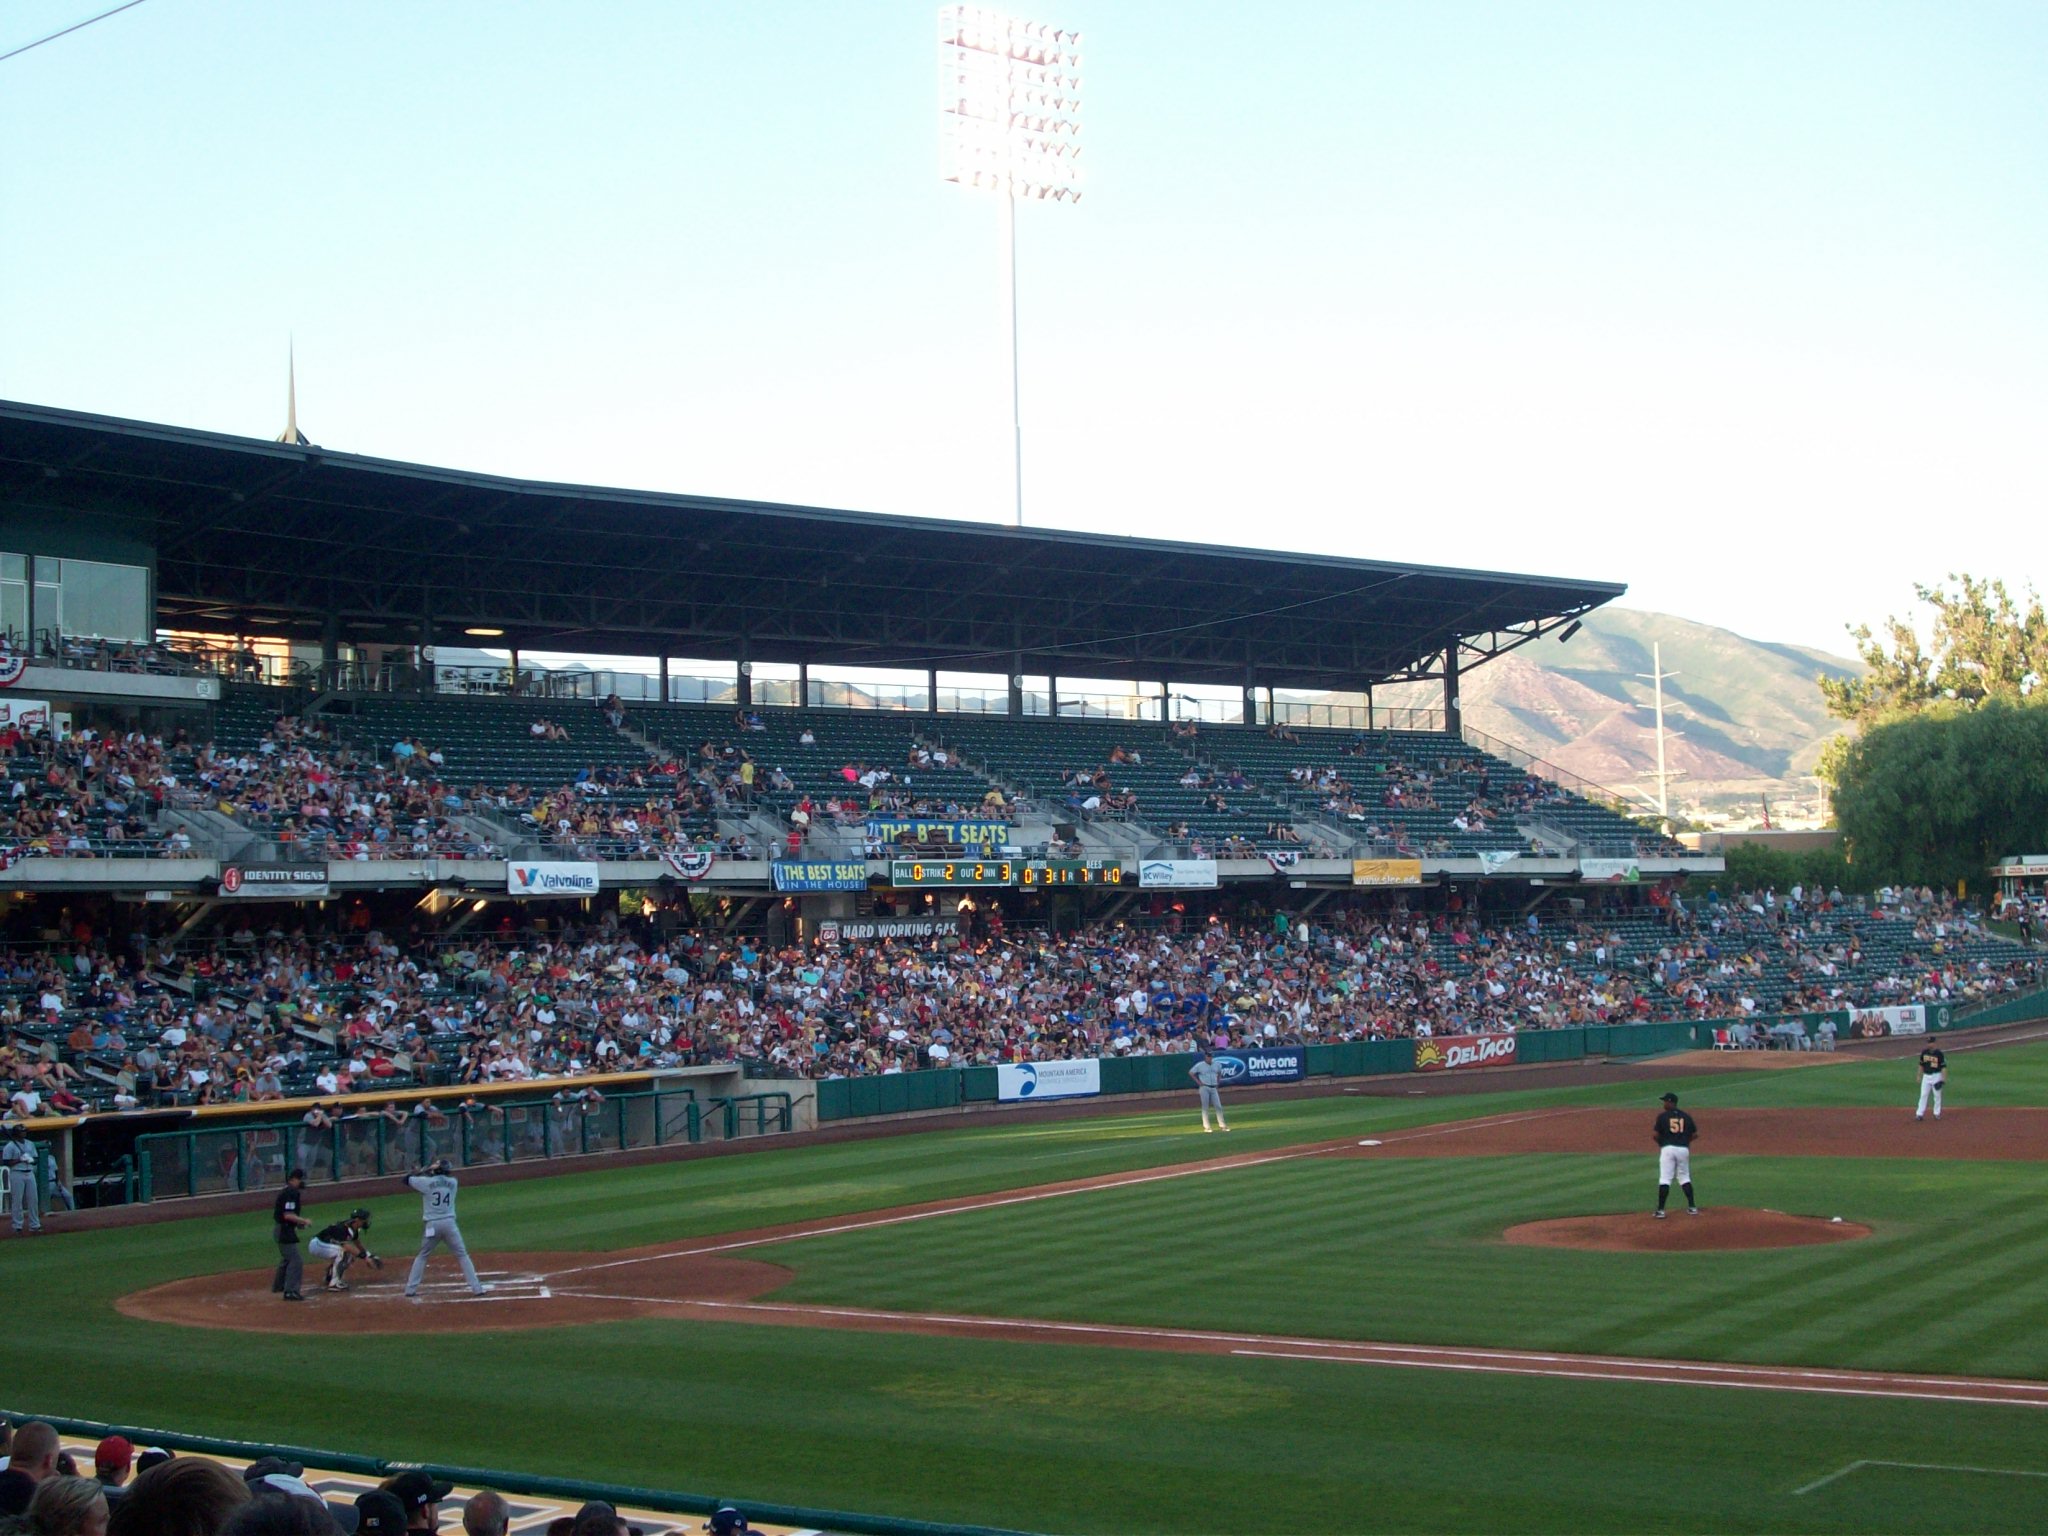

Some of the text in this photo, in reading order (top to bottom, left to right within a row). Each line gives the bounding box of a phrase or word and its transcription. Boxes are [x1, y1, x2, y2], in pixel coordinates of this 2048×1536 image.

[917, 824, 954, 844] BT
[960, 825, 1007, 844] SEATS
[1086, 860, 1103, 869] BEES
[244, 871, 325, 881] IDENTITY SIGNS
[783, 865, 805, 880] THE
[807, 865, 832, 880] BEST
[835, 865, 865, 880] SEATS
[895, 864, 1009, 880] BALL 0 STRIKE 2 OUT 2 INN 3
[1012, 868, 1066, 884] R 0 H 3 E 1
[1068, 872, 1073, 881] R
[1081, 868, 1088, 882] 7
[1088, 872, 1093, 880] H
[1112, 868, 1119, 883] 0
[540, 874, 593, 888] Valvoline
[786, 881, 864, 889] IN THE HOUSE!
[823, 930, 835, 940] 66
[842, 922, 959, 938] HARD WORKING GAS.
[1248, 1056, 1297, 1070] Drive one
[1038, 1067, 1087, 1078] MOUNTAIN AMERICA
[1669, 1118, 1685, 1134] 51
[432, 1192, 450, 1206] 34
